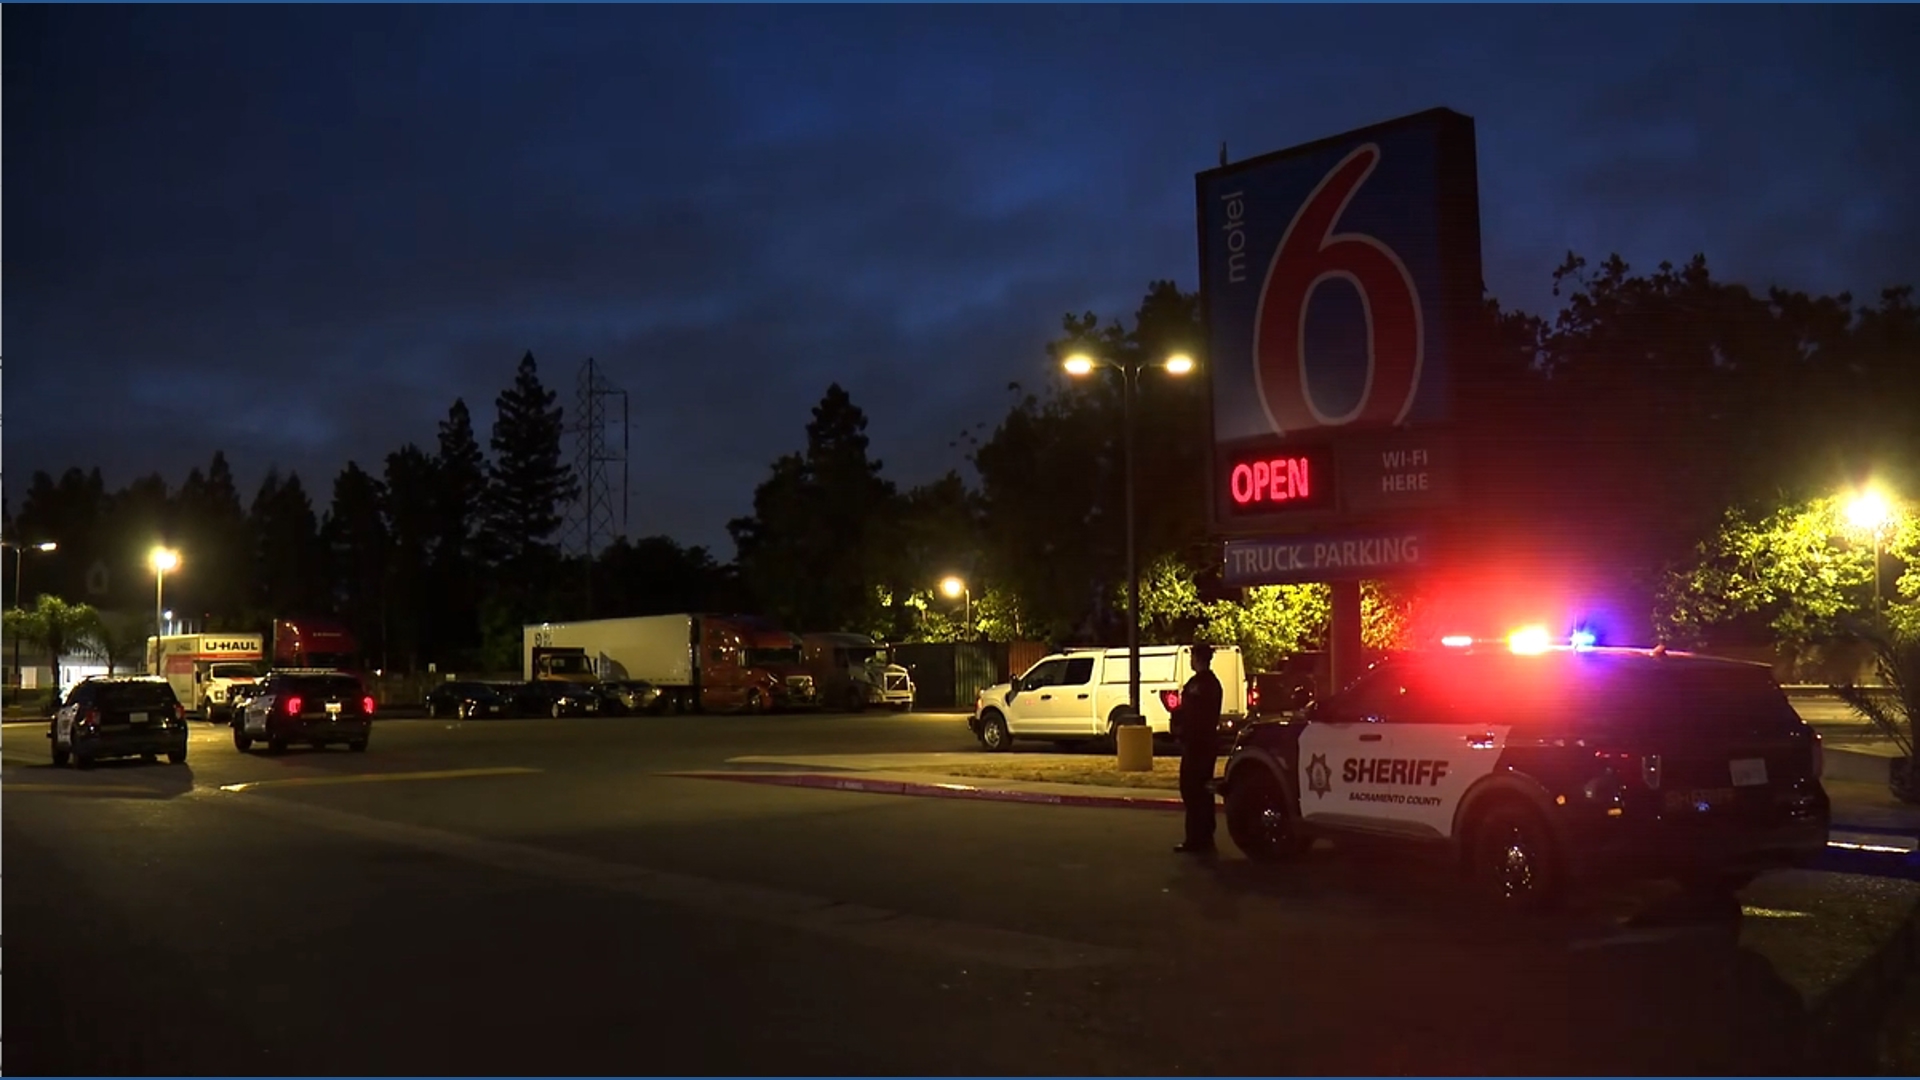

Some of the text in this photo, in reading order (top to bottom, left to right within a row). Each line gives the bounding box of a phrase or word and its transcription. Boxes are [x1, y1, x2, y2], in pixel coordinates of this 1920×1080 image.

[1221, 190, 1246, 283] motel
[1253, 142, 1424, 438] 6
[1382, 450, 1429, 469] WI-FI
[1231, 456, 1309, 503] OPEN
[1382, 473, 1429, 493] HERE
[1232, 536, 1418, 574] TRUCK PARKING
[205, 641, 258, 651] U-HAUL
[1343, 758, 1449, 786] SHERIFF
[1349, 792, 1442, 807] SACRAMENTO COUNTY
